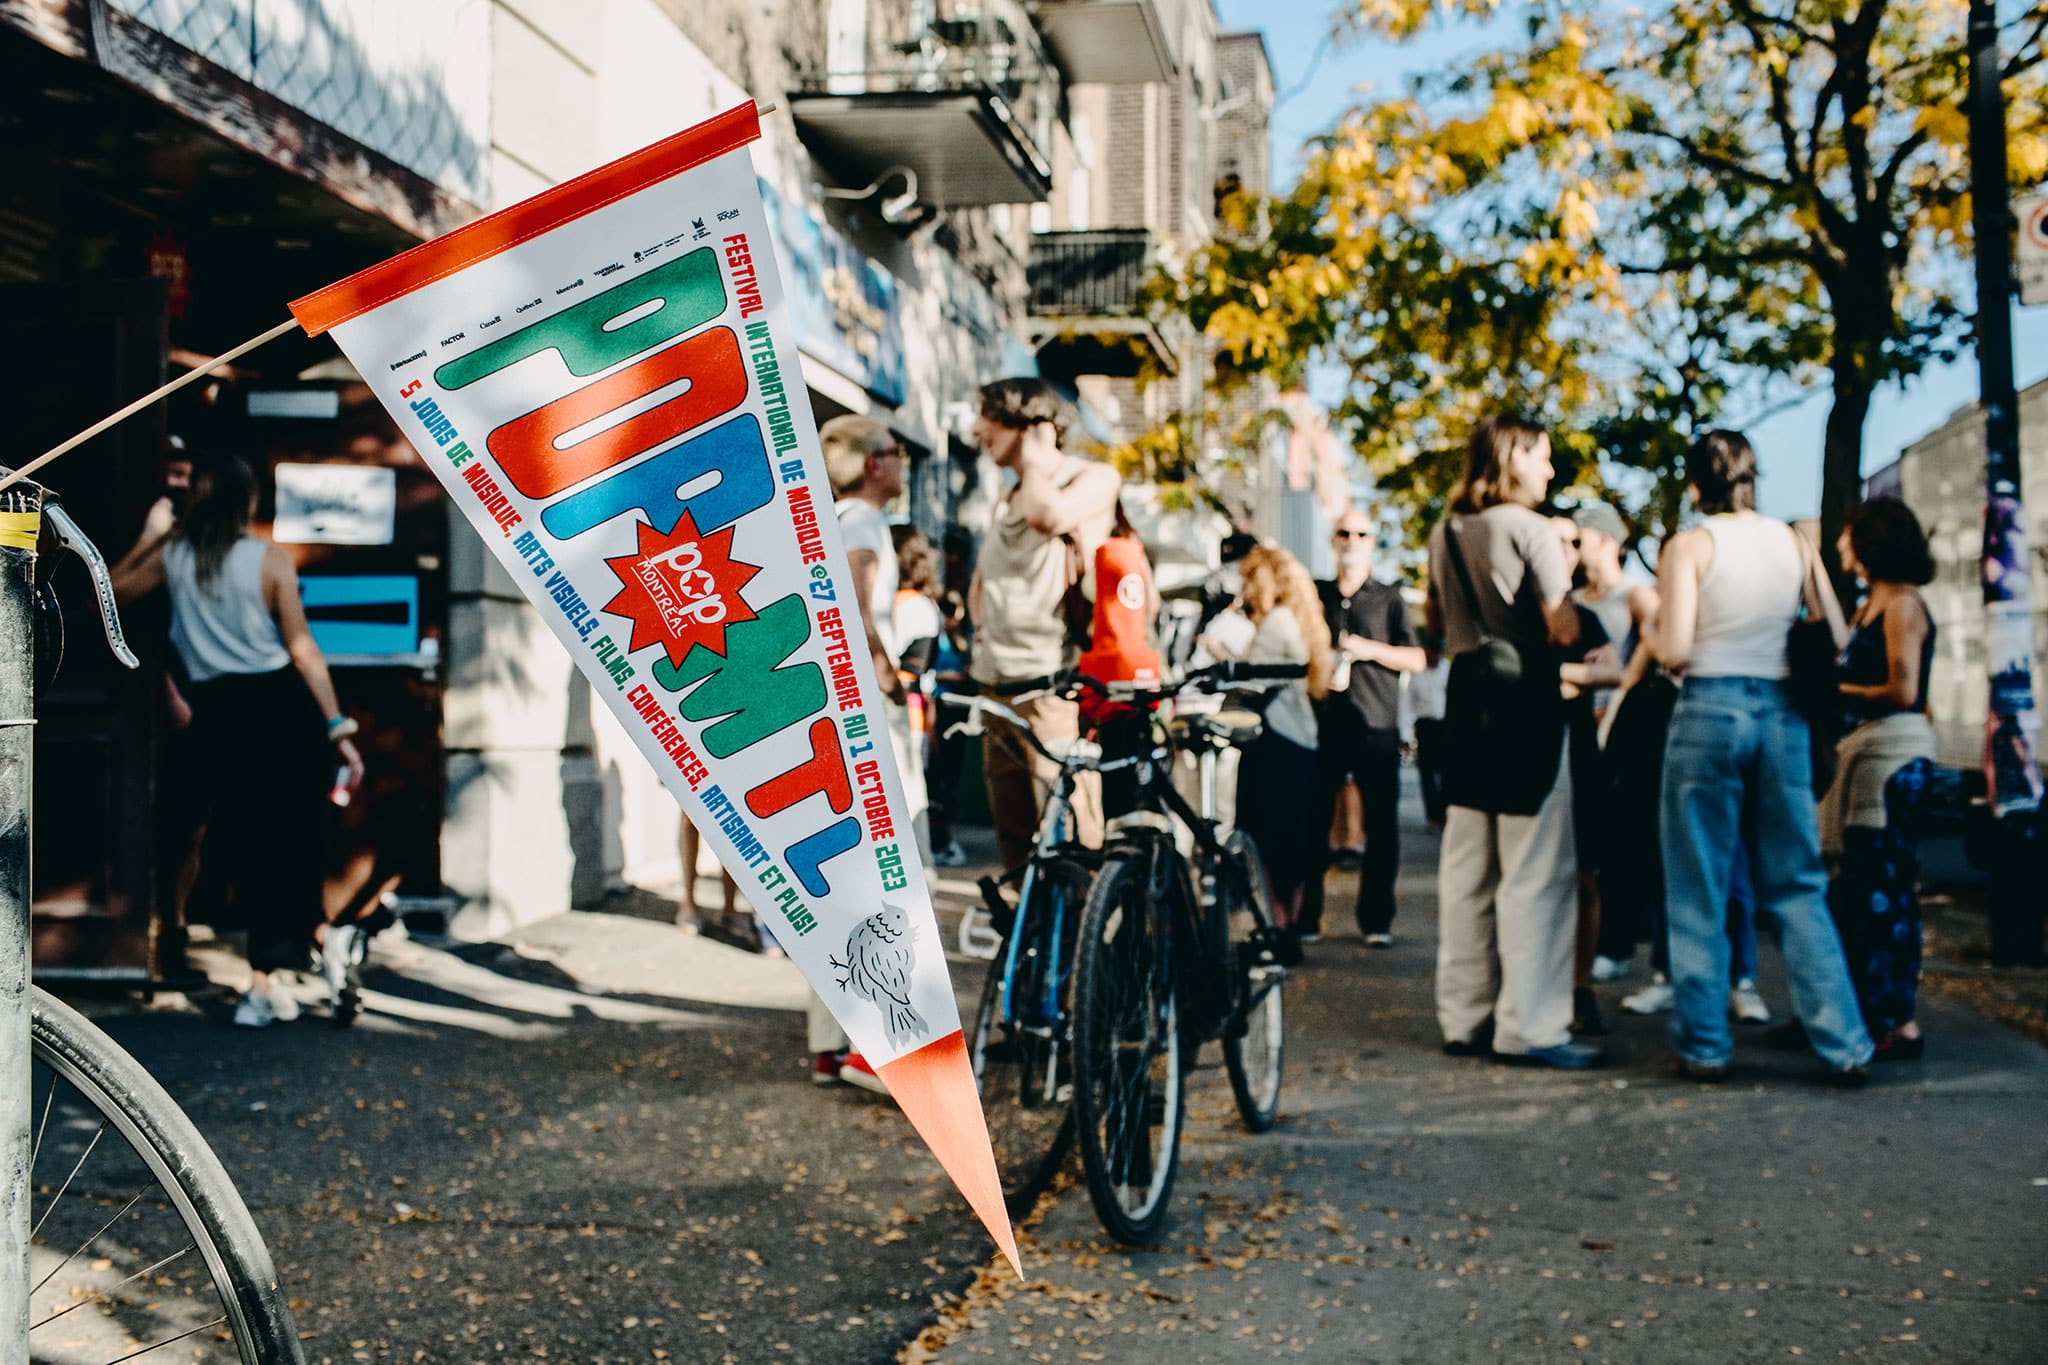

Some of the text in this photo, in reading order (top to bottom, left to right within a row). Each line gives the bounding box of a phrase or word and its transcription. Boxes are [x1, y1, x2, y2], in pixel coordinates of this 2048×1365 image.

[722, 233, 764, 319] FESTIVAL
[440, 332, 466, 348] FACTOR
[744, 320, 799, 458] INTERNATIONAL
[778, 459, 806, 484] DE
[785, 486, 826, 565] MUSIQUE
[434, 246, 863, 898] POP MTL
[636, 560, 688, 637] MONTRÉAL
[400, 379, 819, 937] 5 JOURS DE MUSIQUE, ARTS VISUELS, FILMS, CONFÉRENCES, ARTISANAT ET PLUS!
[816, 607, 863, 712] SEPTEMBRE
[842, 713, 870, 740] AU
[849, 741, 874, 758] 1
[854, 759, 896, 842] OCTOBRE
[875, 843, 908, 893] 2023
